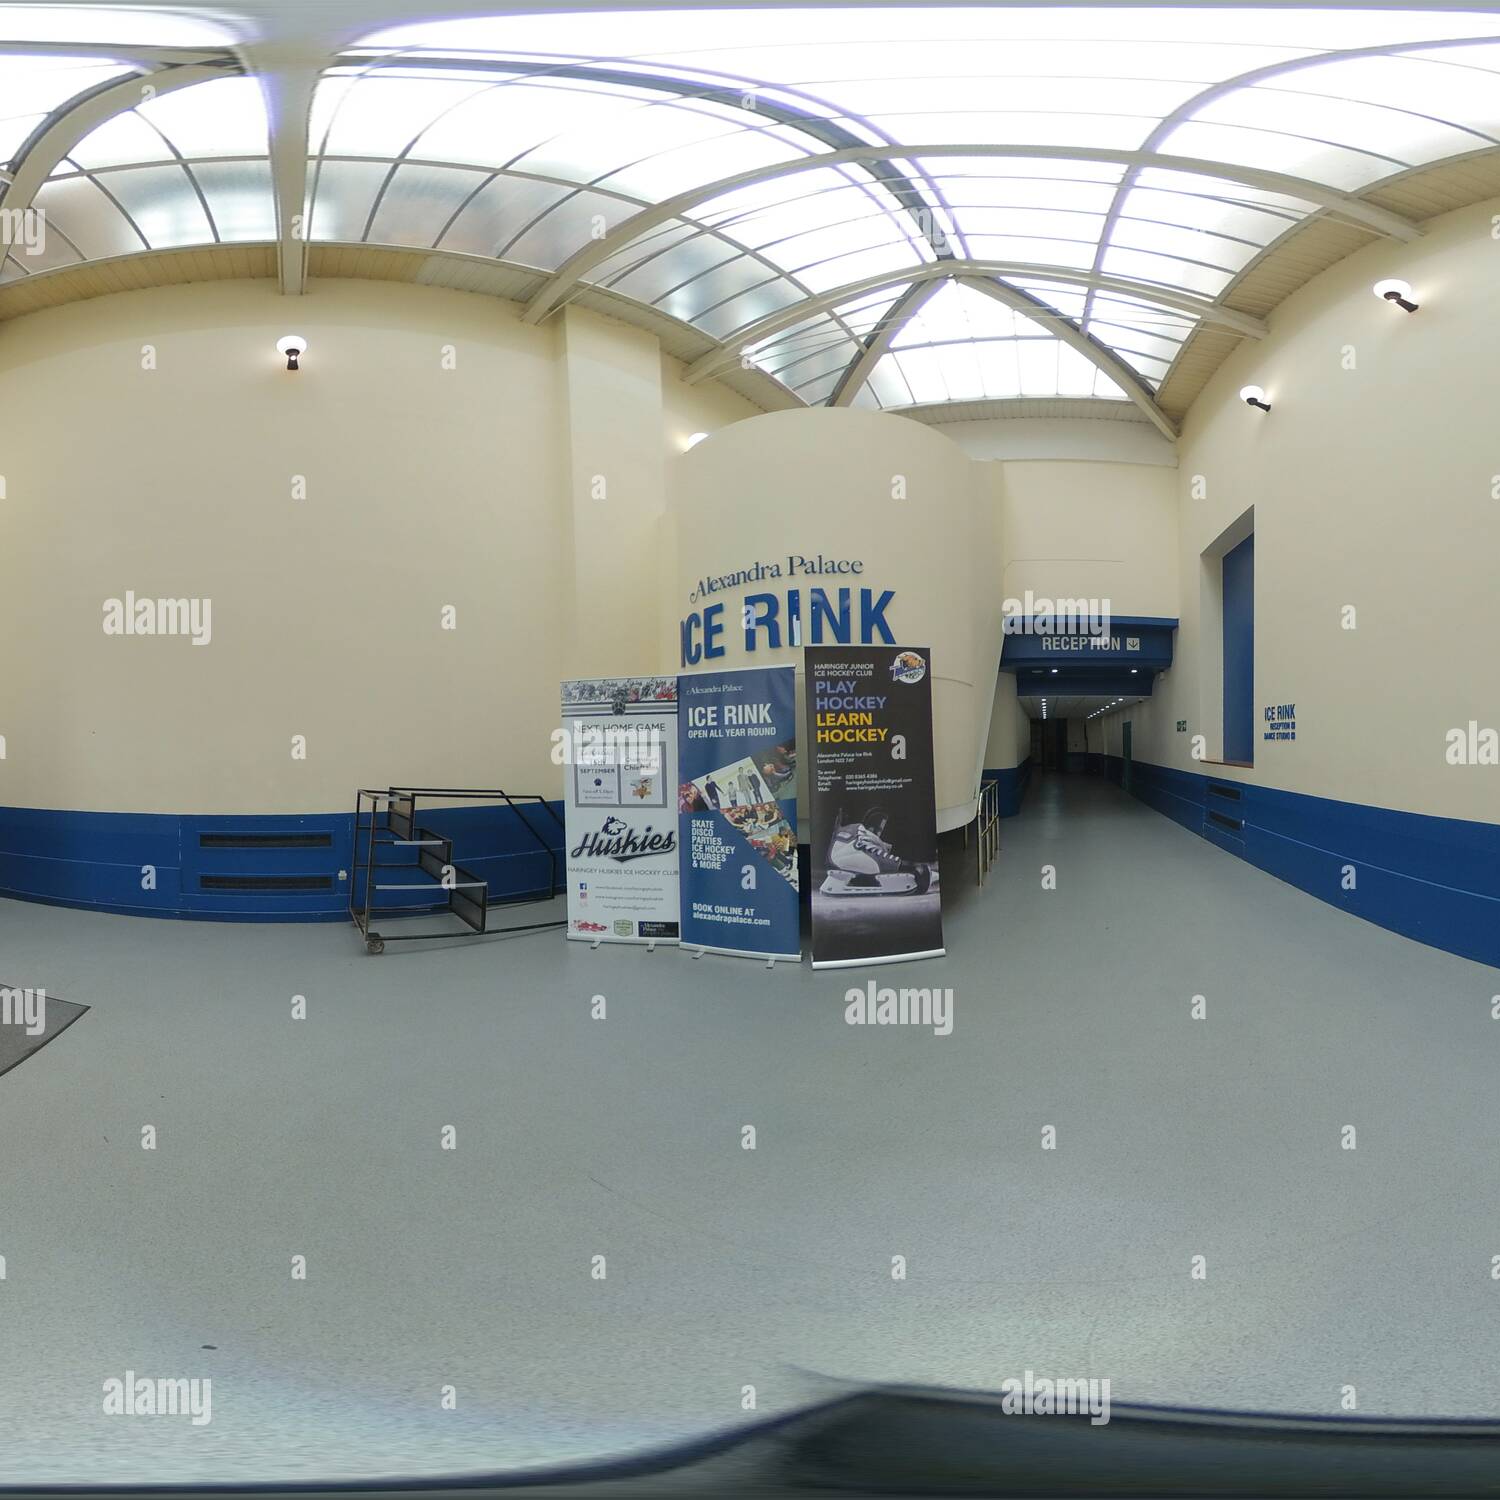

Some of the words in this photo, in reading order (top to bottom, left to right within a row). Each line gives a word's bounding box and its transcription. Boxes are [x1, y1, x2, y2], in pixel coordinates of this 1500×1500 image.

[689, 561, 781, 604] Alexandra
[786, 554, 865, 577] Palace
[680, 601, 726, 669] ICE
[744, 587, 898, 652] RINK
[1042, 636, 1121, 651] RECEPTION
[686, 686, 722, 695] Alexandra
[722, 684, 743, 692] Palace
[816, 680, 856, 694] PLAY
[816, 696, 887, 710] HOCKEY
[688, 706, 718, 727] ICE
[724, 703, 772, 726] RINK
[816, 712, 872, 726] LEARN
[1264, 706, 1276, 722] ICE
[1277, 704, 1296, 721] RINK
[574, 724, 600, 734] NEXT
[603, 723, 634, 733] HOME
[636, 722, 666, 732] GAME
[688, 729, 708, 739] OPEN
[709, 728, 724, 738] ALL
[725, 728, 746, 737] YEAR
[748, 726, 776, 736] ROUND
[1270, 722, 1291, 730] RECEPTION
[817, 728, 888, 743] HOCKEY
[691, 820, 714, 828] SKATE
[692, 828, 714, 836] DISCO
[571, 826, 677, 860] Huskies
[692, 836, 722, 846] PARTIES
[692, 844, 703, 852] ICE
[704, 846, 736, 855] HOCKEY
[692, 852, 727, 862] COURSES
[692, 860, 698, 868] &
[700, 861, 722, 870] MORE
[692, 902, 713, 912] BOOK
[714, 904, 743, 915] ONLINE
[744, 908, 755, 916] AT
[692, 912, 770, 926] alexandrapalace.com
